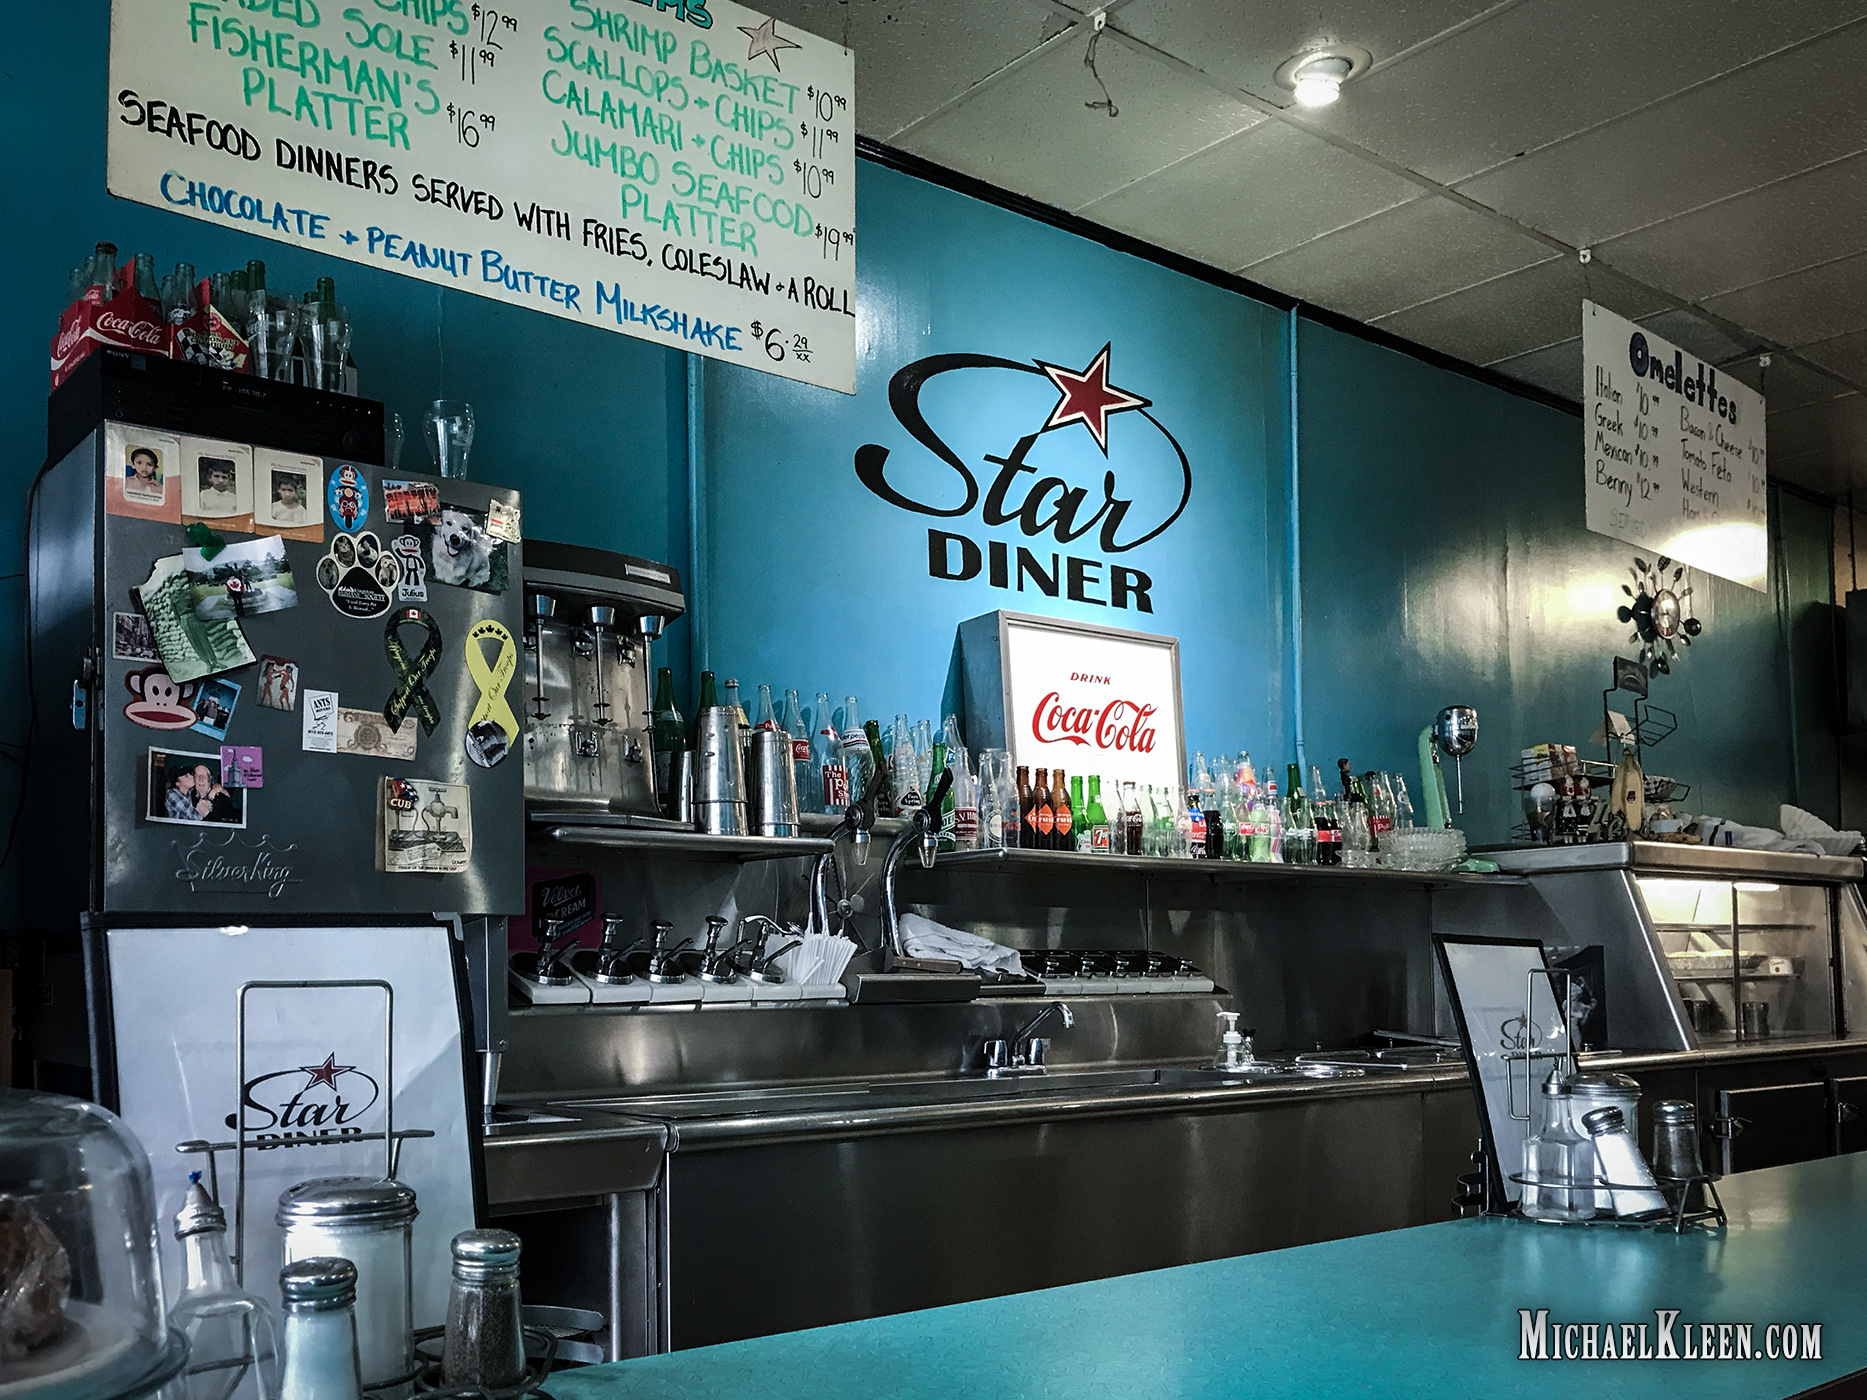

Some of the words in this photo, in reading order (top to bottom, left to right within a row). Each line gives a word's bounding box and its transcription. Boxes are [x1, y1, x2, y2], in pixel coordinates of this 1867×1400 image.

[187, 2, 441, 115] FISHERMAN'S
[343, 8, 439, 70] SOLE
[570, 0, 677, 64] SHRIMP
[690, 40, 800, 114] BASKET
[242, 66, 411, 150] PLATTER
[543, 26, 689, 111] SCALLOPS
[714, 94, 795, 151] CHIPS
[542, 69, 683, 152] CALAMARI
[710, 134, 785, 186] CHIPS
[118, 89, 262, 161] SEAFOOD
[275, 138, 399, 195] DINNERS
[412, 173, 504, 222] SERVED
[514, 201, 572, 242] WITH
[582, 218, 652, 267] FRIES,
[661, 244, 771, 296] COLESLAW
[788, 277, 799, 303] A
[804, 276, 855, 318] ROLL
[551, 120, 661, 186] JUMBO
[671, 161, 814, 238] SEAFOOD
[620, 184, 758, 257] PLATTER
[160, 169, 331, 239] CHOCOLATE
[365, 226, 473, 278] PEANUT
[481, 250, 581, 313] BUTTER
[596, 280, 743, 352] MILKSHAKE
[96, 311, 163, 345] Coca-Cola
[1629, 332, 1737, 425] Omelettes
[1594, 430, 1632, 465] Mexican
[1595, 402, 1623, 437] Greek
[1715, 424, 1743, 460] Cheese
[854, 352, 1193, 554] Star
[1711, 451, 1732, 483] Feta
[401, 588, 425, 598] Julius
[927, 527, 1154, 615] DINER
[408, 670, 421, 686] Our
[1070, 672, 1112, 685] DRINK
[1032, 691, 1158, 753] Coca-Cola
[390, 798, 413, 809] CUB
[541, 885, 582, 907] Velvet
[225, 1066, 379, 1131] Star
